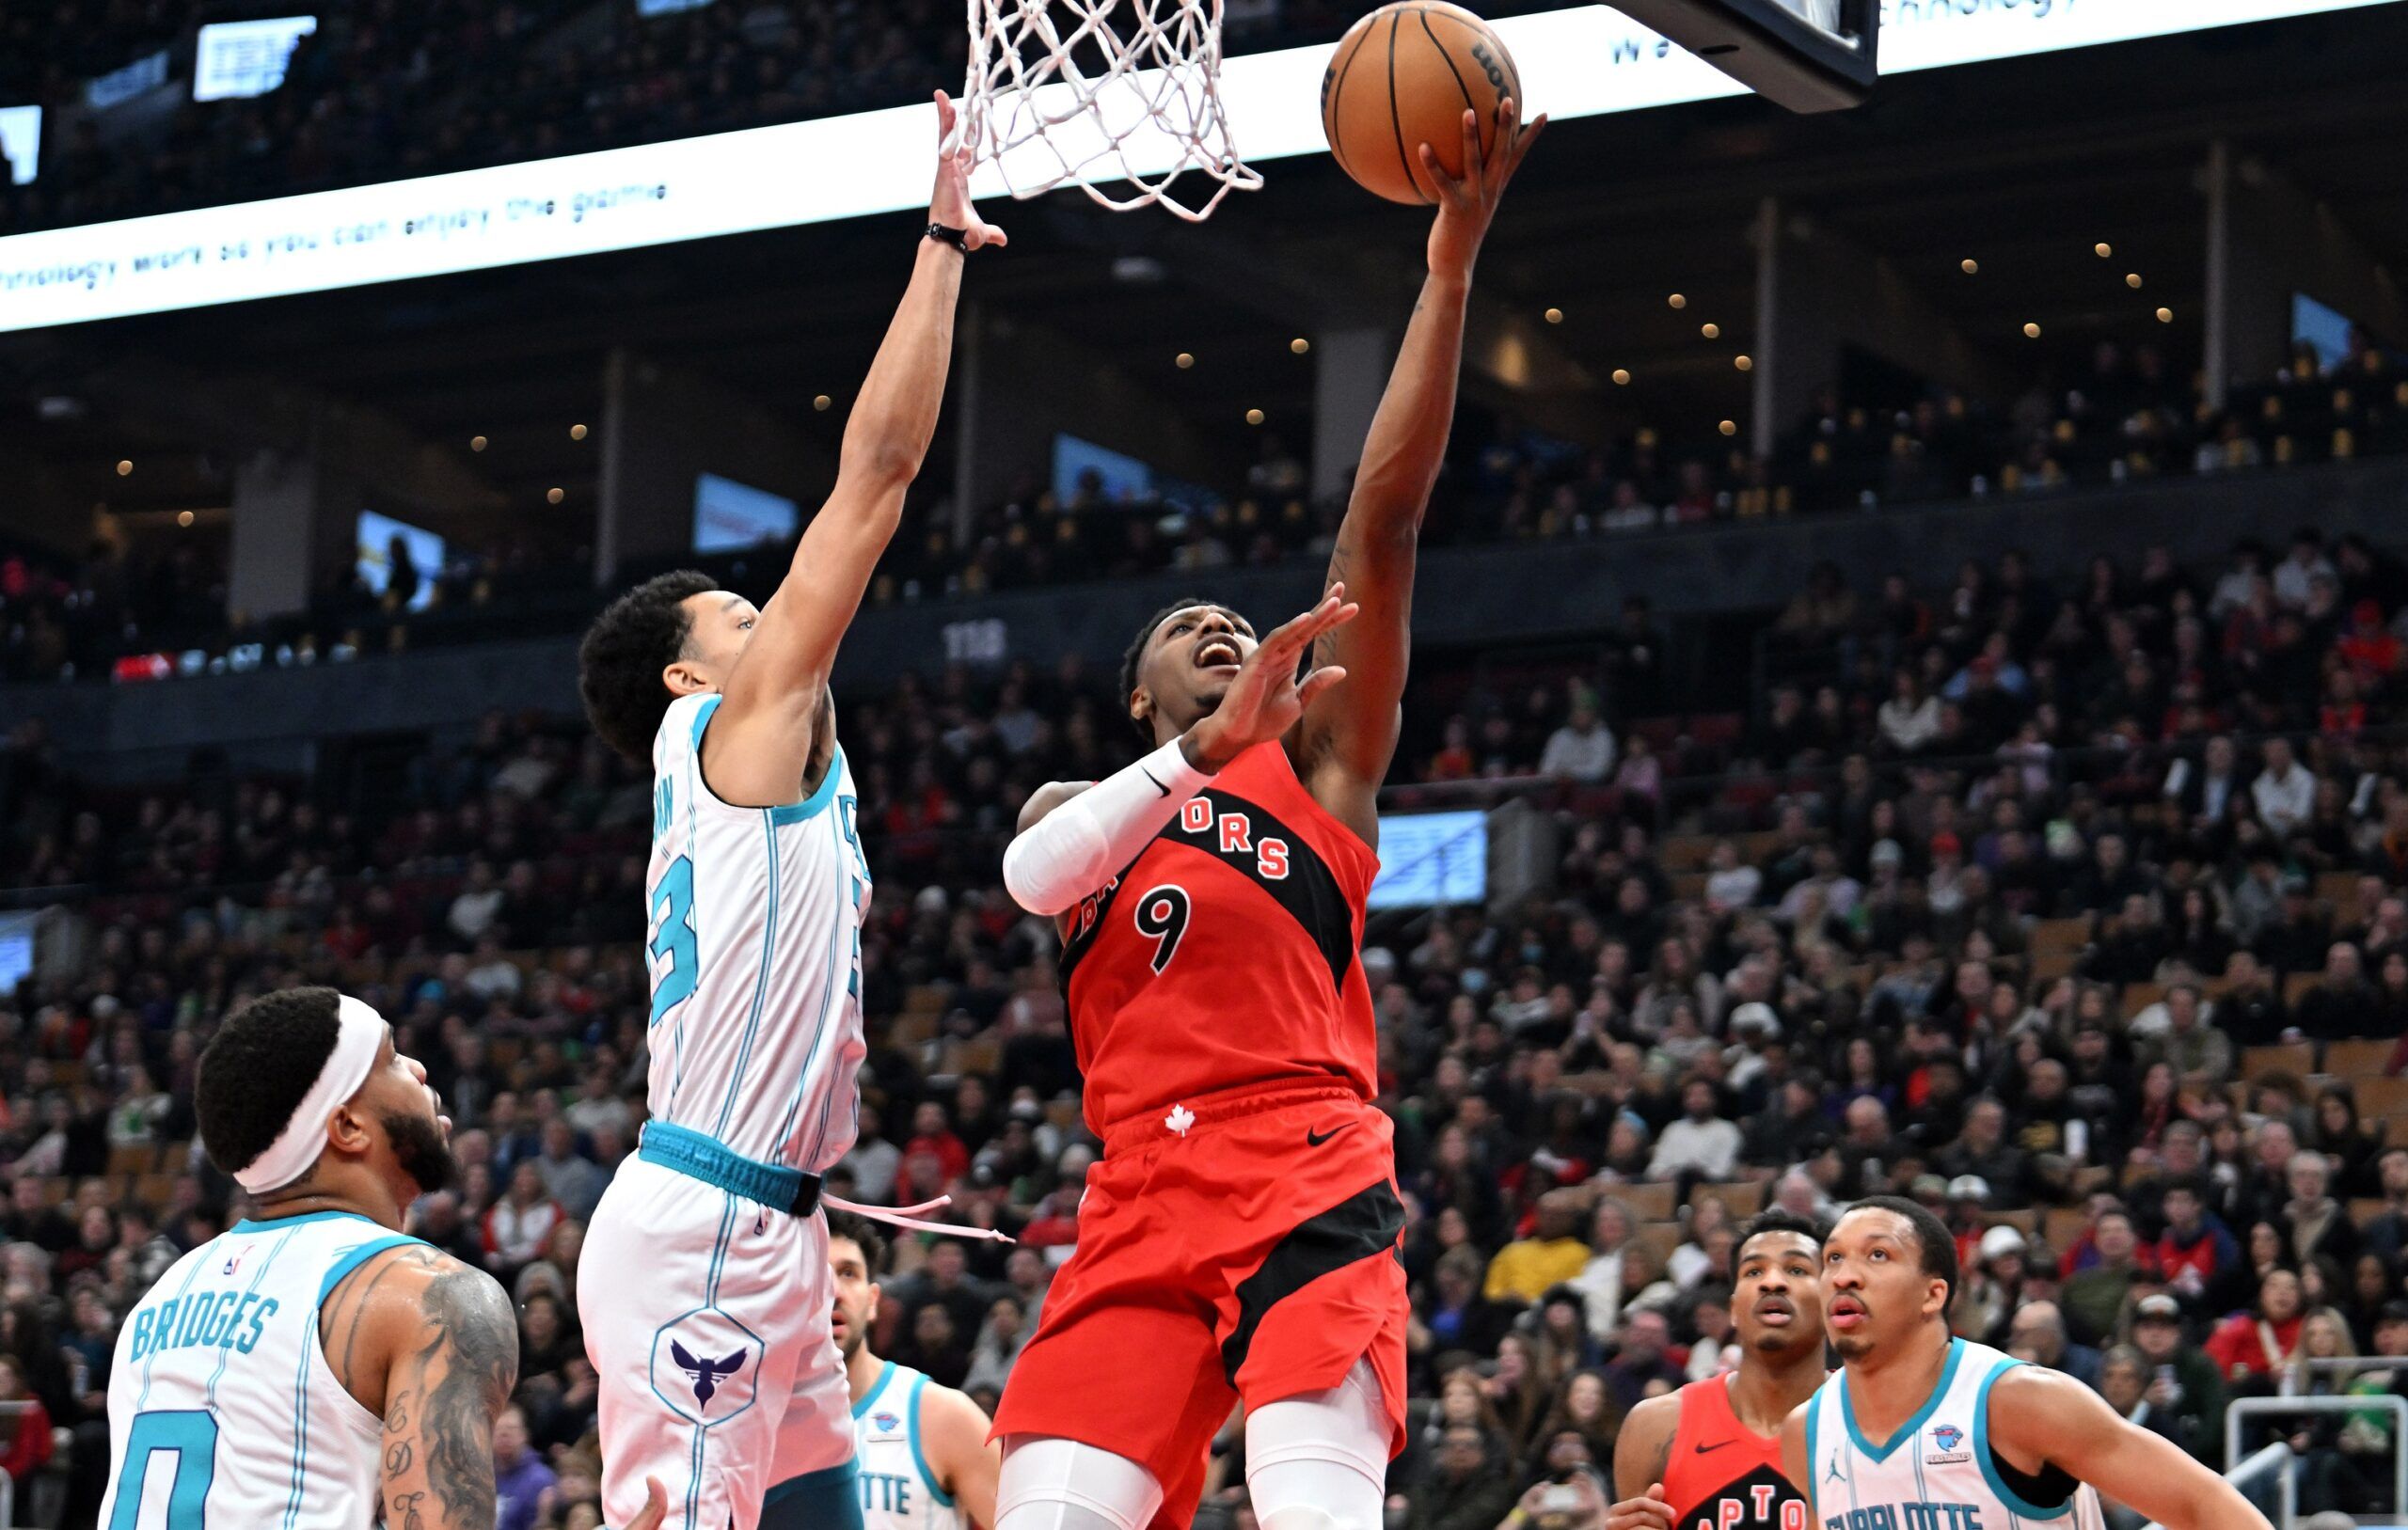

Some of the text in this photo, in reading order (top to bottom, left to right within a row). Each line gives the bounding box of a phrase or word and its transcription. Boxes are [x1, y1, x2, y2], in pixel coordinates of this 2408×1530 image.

[646, 853, 699, 1030] 3
[1133, 883, 1192, 978] 9
[130, 1290, 279, 1364] BRIDGES
